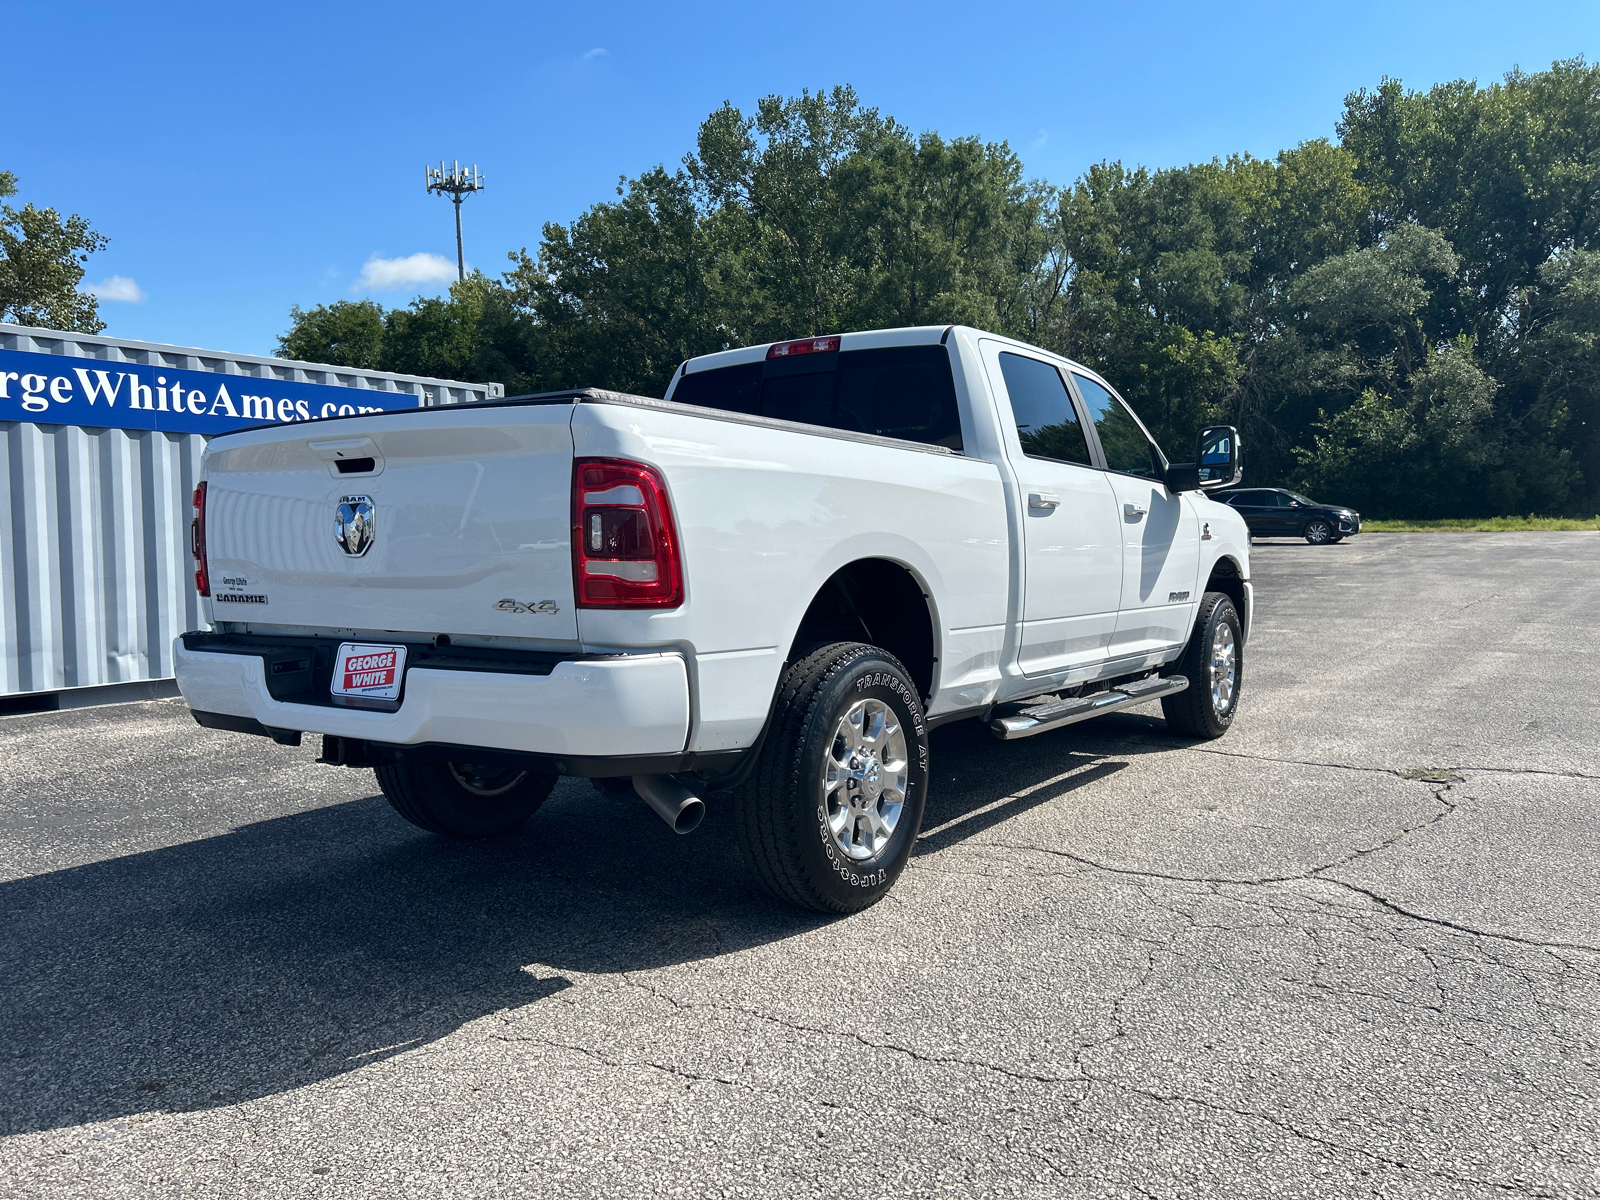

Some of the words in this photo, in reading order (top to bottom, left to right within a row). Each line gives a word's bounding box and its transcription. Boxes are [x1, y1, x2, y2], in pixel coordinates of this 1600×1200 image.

[0, 367, 384, 423] rgeWhiteAmes.co
[216, 593, 267, 604] LARAMIE
[347, 653, 394, 671] GEORGE
[351, 671, 387, 687] WHITE
[856, 672, 925, 737] TRANSFORCE
[918, 744, 928, 772] AT
